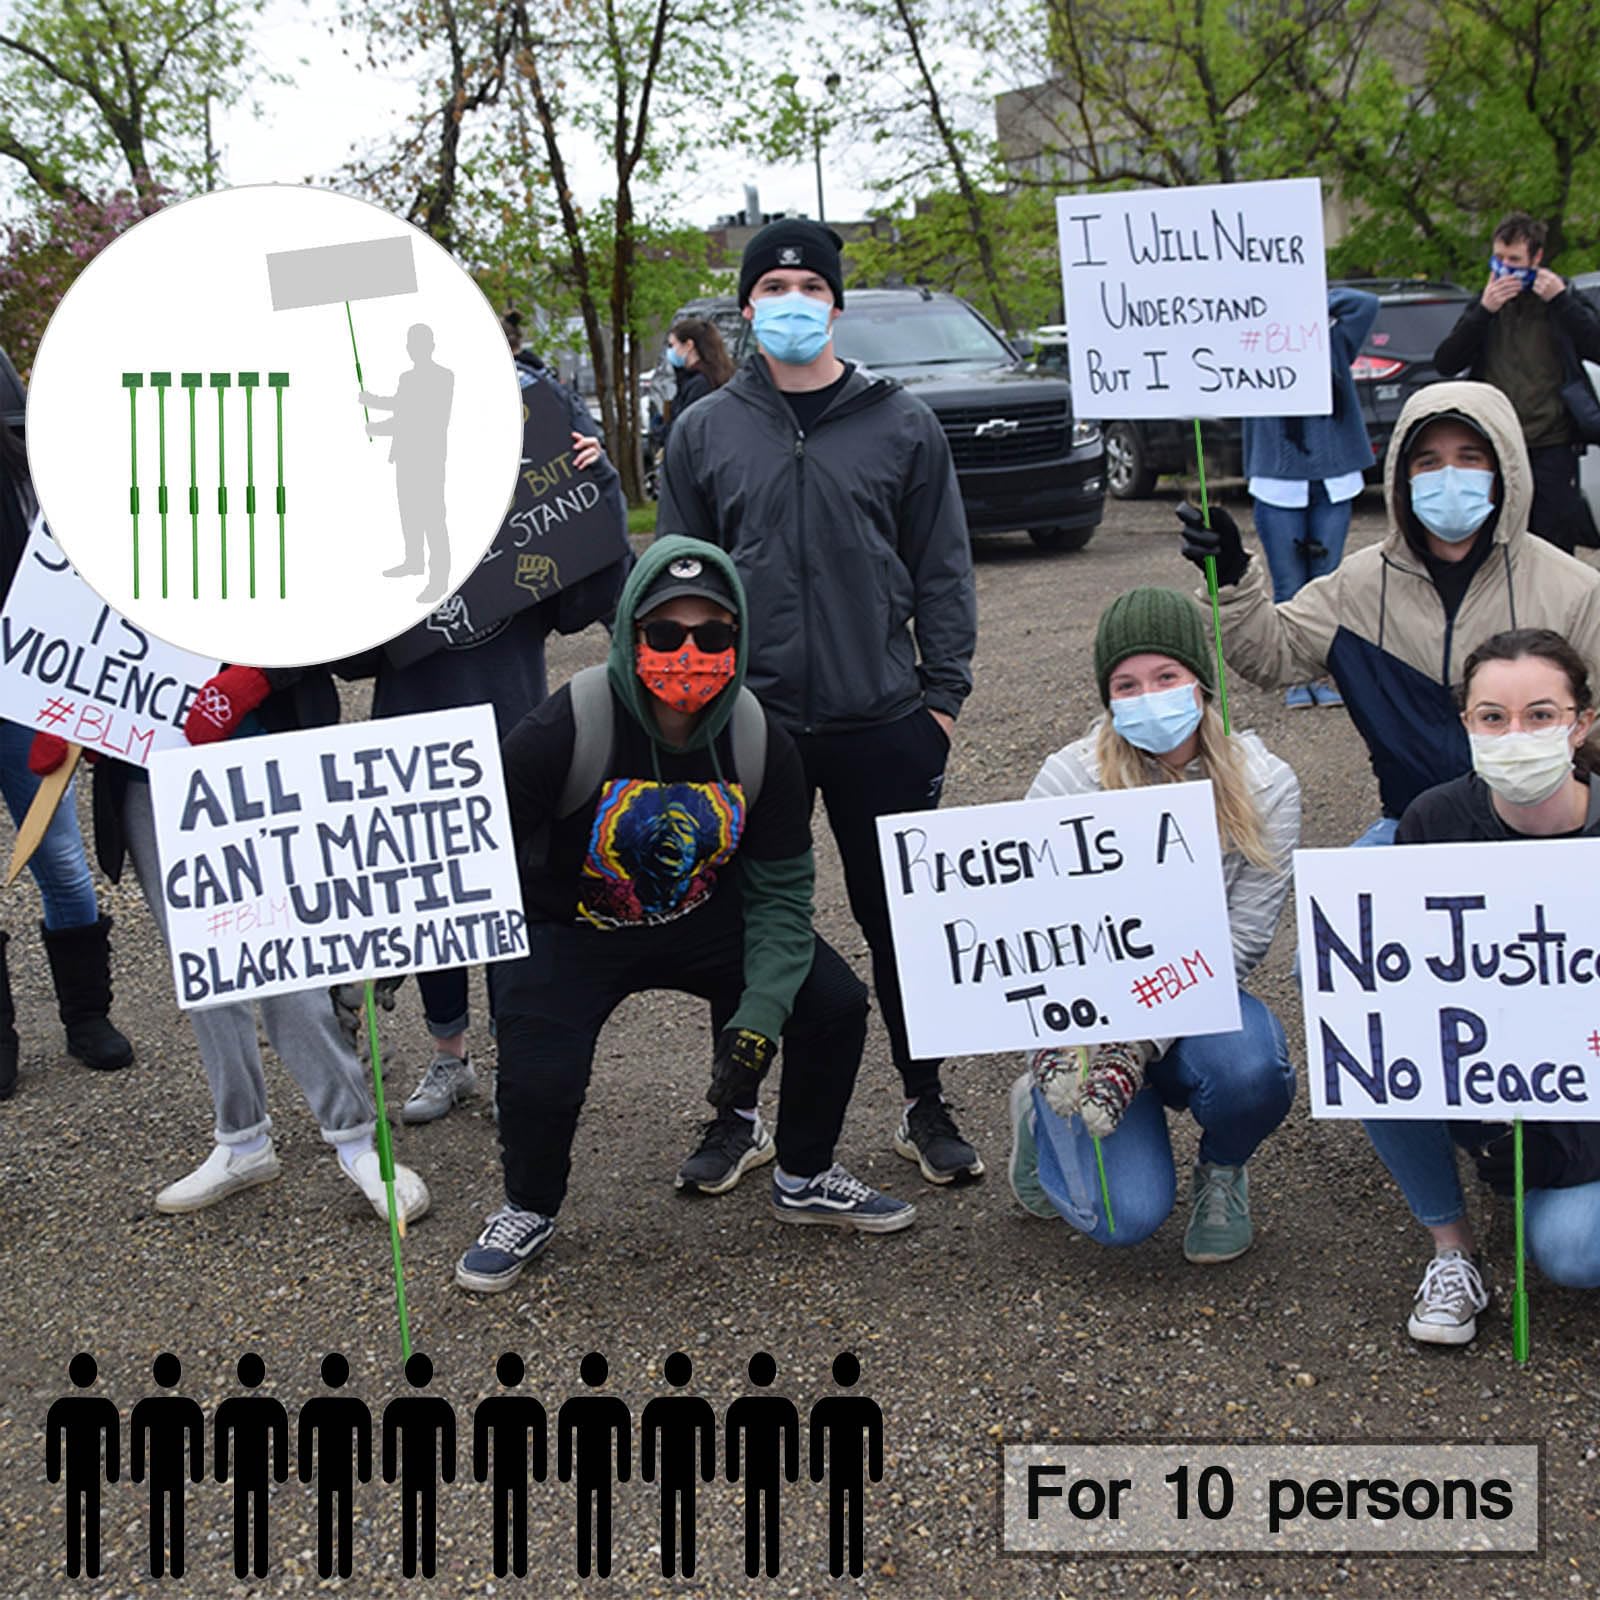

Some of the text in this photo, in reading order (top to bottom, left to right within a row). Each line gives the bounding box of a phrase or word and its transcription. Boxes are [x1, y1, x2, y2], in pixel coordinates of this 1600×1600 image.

[1070, 208, 1304, 267] I WILL NEVER
[1100, 280, 1267, 329] UNDERSTAND
[1240, 322, 1323, 354] #BLM
[1087, 348, 1297, 394] BUT I STAND
[523, 452, 575, 497] BUT
[509, 481, 600, 547] STAND
[2, 616, 200, 730] VIOLENCE
[36, 696, 156, 764] #BLM
[180, 739, 483, 831] ALL LIVES
[166, 795, 499, 909] CAN'T MATTER
[1157, 812, 1194, 864] A
[208, 896, 291, 937] #BLM
[290, 859, 492, 924] UNTIL
[179, 938, 297, 1002] BLACK
[302, 927, 411, 978] LIVES
[414, 909, 527, 967] MATTER
[1310, 893, 1600, 992] No Justic
[1131, 949, 1214, 1008] #BLM
[1320, 1007, 1588, 1106] No Peace
